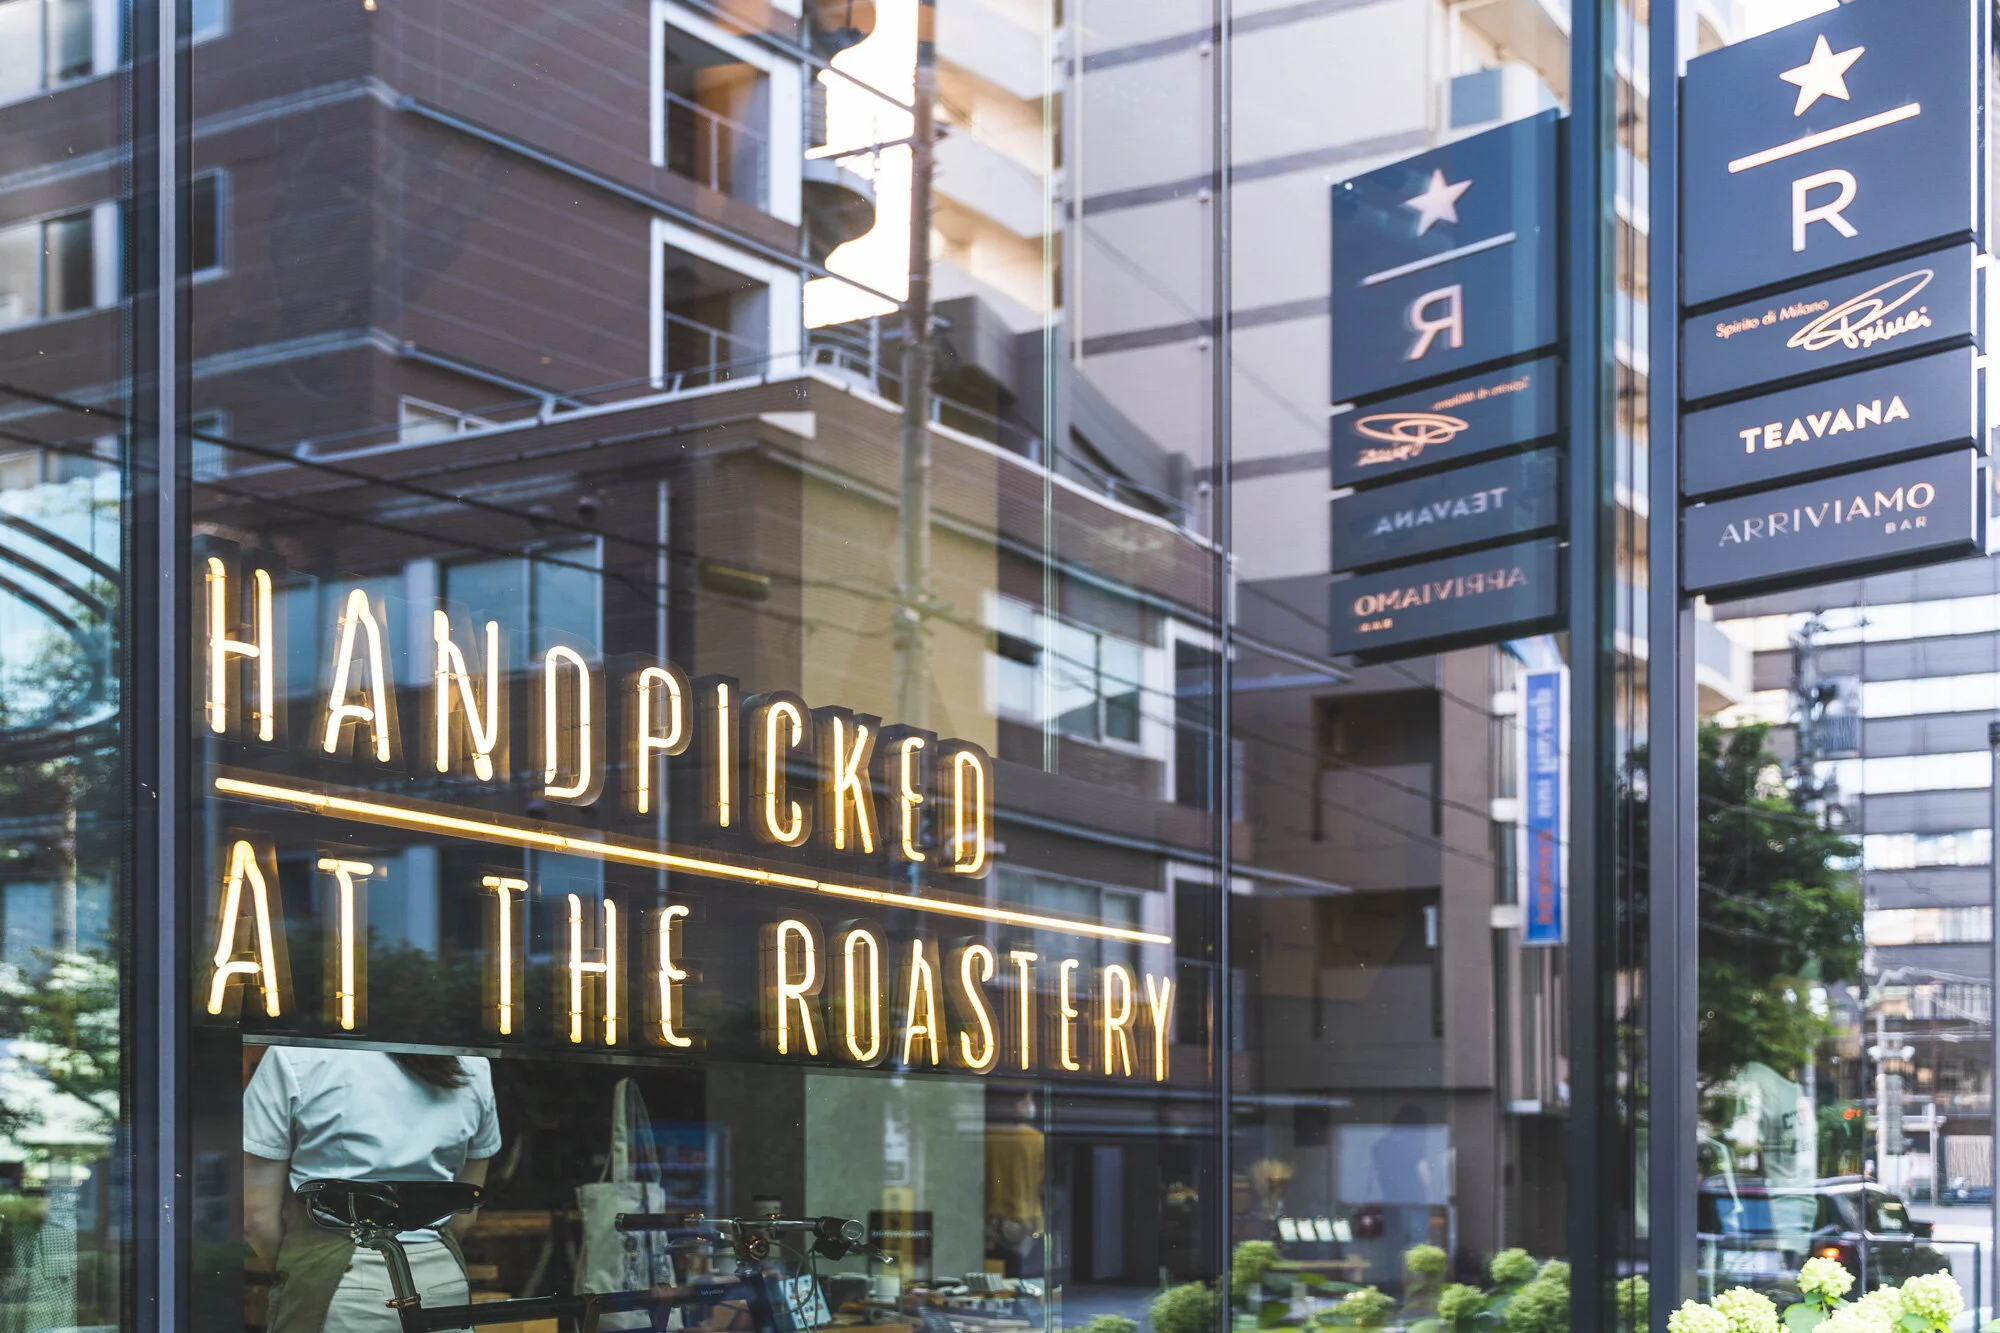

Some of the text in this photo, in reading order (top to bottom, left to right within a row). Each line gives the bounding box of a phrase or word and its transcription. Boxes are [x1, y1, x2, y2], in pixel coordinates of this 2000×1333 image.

[1791, 168, 1859, 253] R
[1715, 299, 1830, 339] Spirito di Milano
[1739, 394, 1911, 454] TEAVANA
[1718, 482, 1936, 547] ARRIVIAMO
[1884, 515, 1928, 535] BAR
[205, 555, 989, 874] HANDPICKED
[206, 839, 1172, 1083] AT THE ROASTERY
